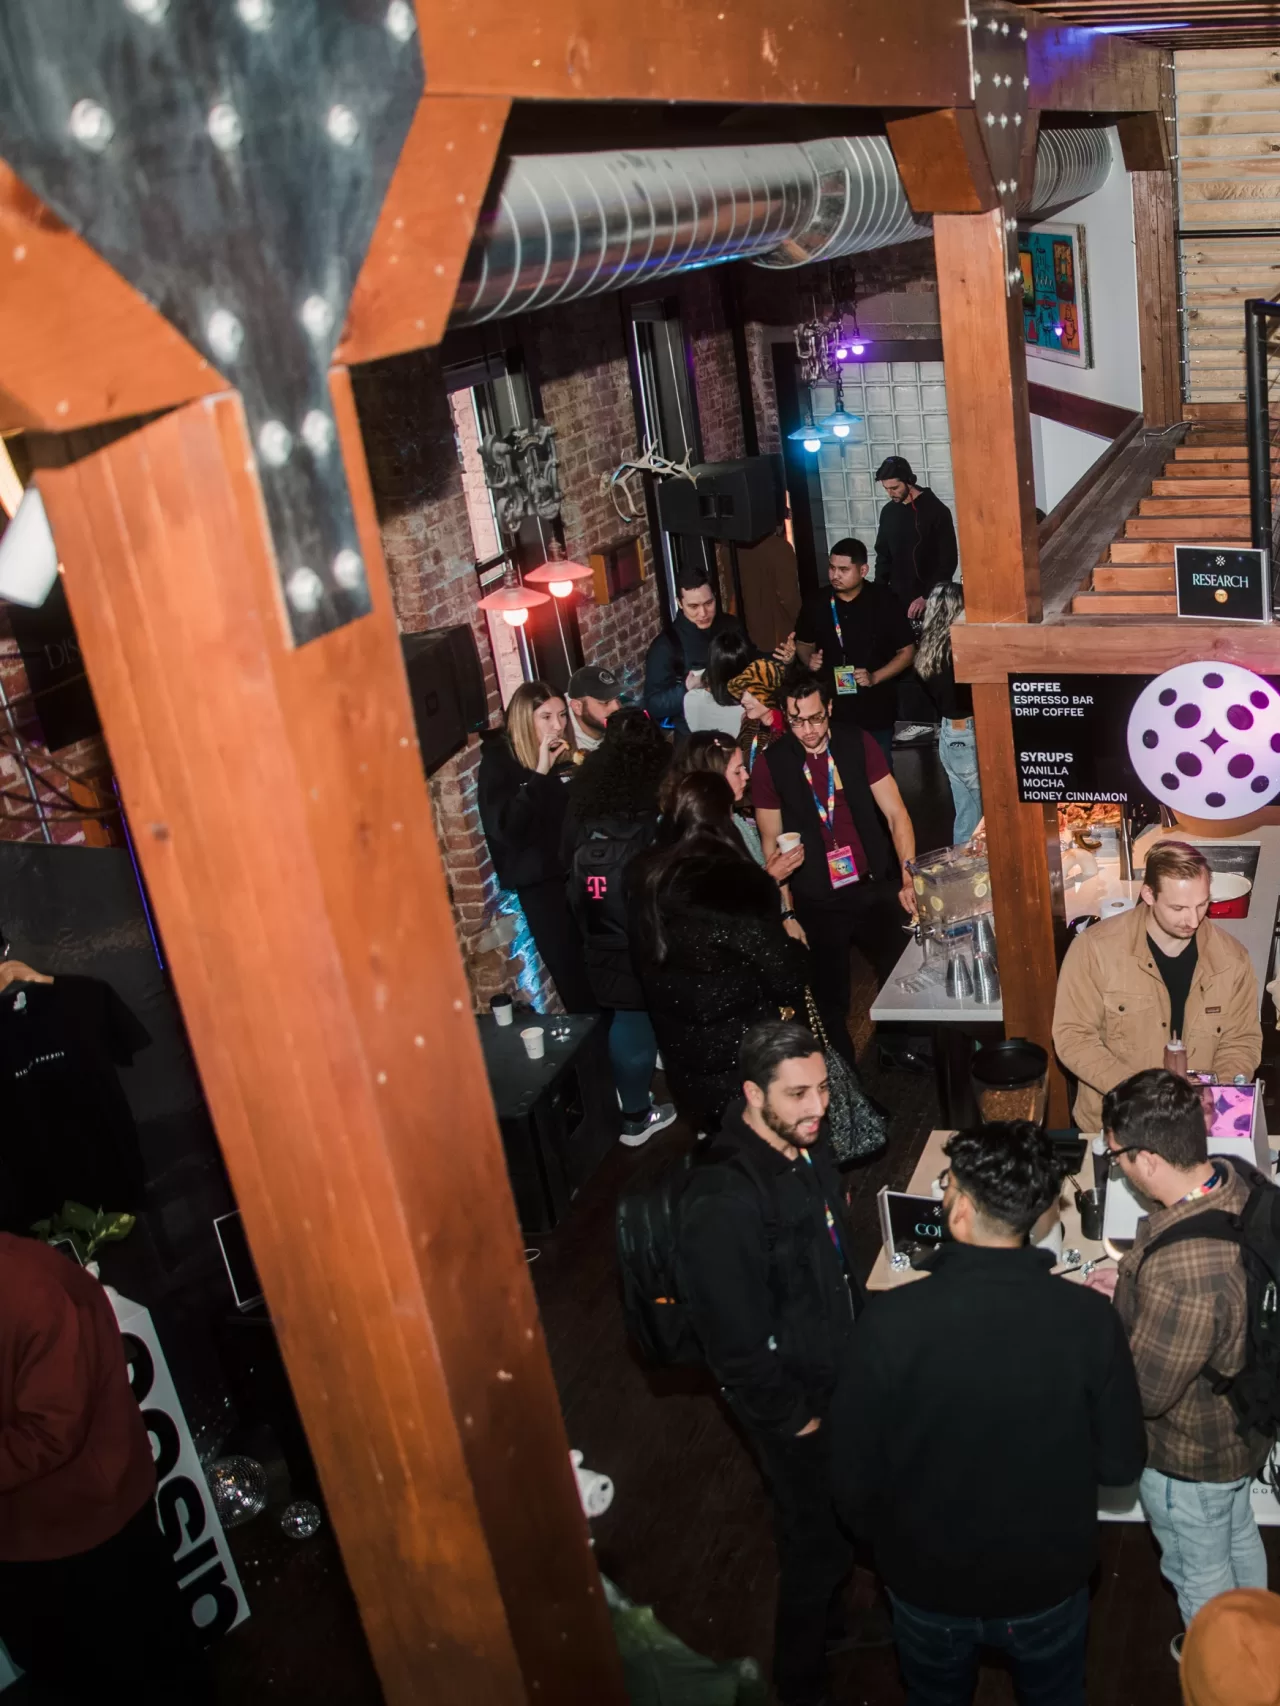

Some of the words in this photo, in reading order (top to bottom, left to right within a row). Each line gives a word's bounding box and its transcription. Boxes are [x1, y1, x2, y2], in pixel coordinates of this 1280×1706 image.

[1192, 573, 1249, 588] RESEARCH
[1012, 682, 1061, 692] COFFEE
[1013, 695, 1069, 704] ESPRESSO
[1072, 695, 1094, 705] BAR
[1015, 707, 1040, 716] DRIP
[1042, 707, 1085, 717] COFFEE
[1020, 752, 1074, 762] SYRUPS
[1021, 765, 1069, 775] VANILLA
[1023, 778, 1065, 788] MOCHA
[1023, 791, 1063, 801] HONEY
[1065, 791, 1128, 802] CINNAMON
